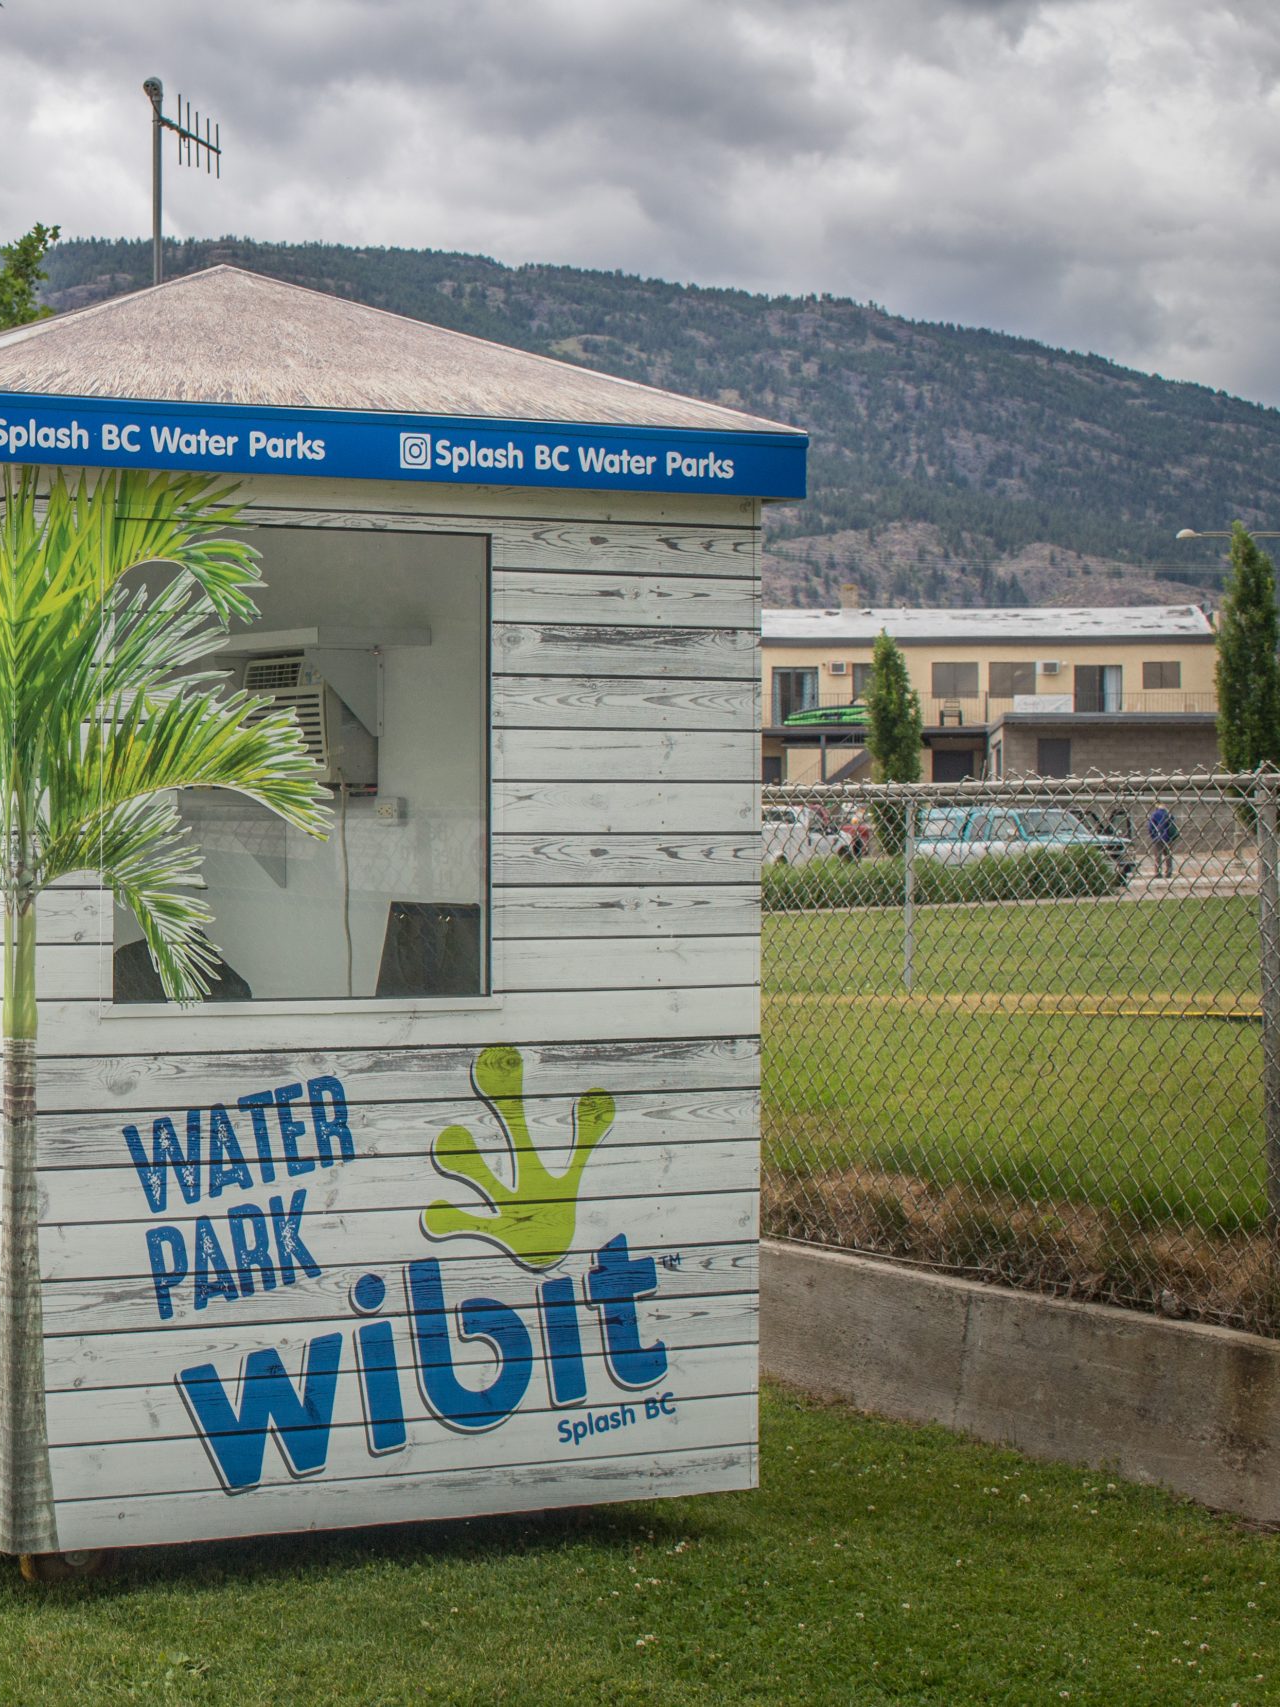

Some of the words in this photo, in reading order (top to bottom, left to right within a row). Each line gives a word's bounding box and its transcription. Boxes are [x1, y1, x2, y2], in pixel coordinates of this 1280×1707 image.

[101, 424, 141, 453] BC
[151, 426, 239, 457] Water
[249, 431, 326, 461] Parks
[435, 439, 523, 474] Splash
[535, 445, 570, 472] BC
[578, 447, 657, 475] Water
[666, 451, 735, 480] Parks
[122, 1076, 355, 1213] WATER
[144, 1189, 322, 1321] PARK
[174, 1233, 670, 1496] wibit
[556, 1404, 637, 1446] Splash
[644, 1391, 677, 1421] BC
